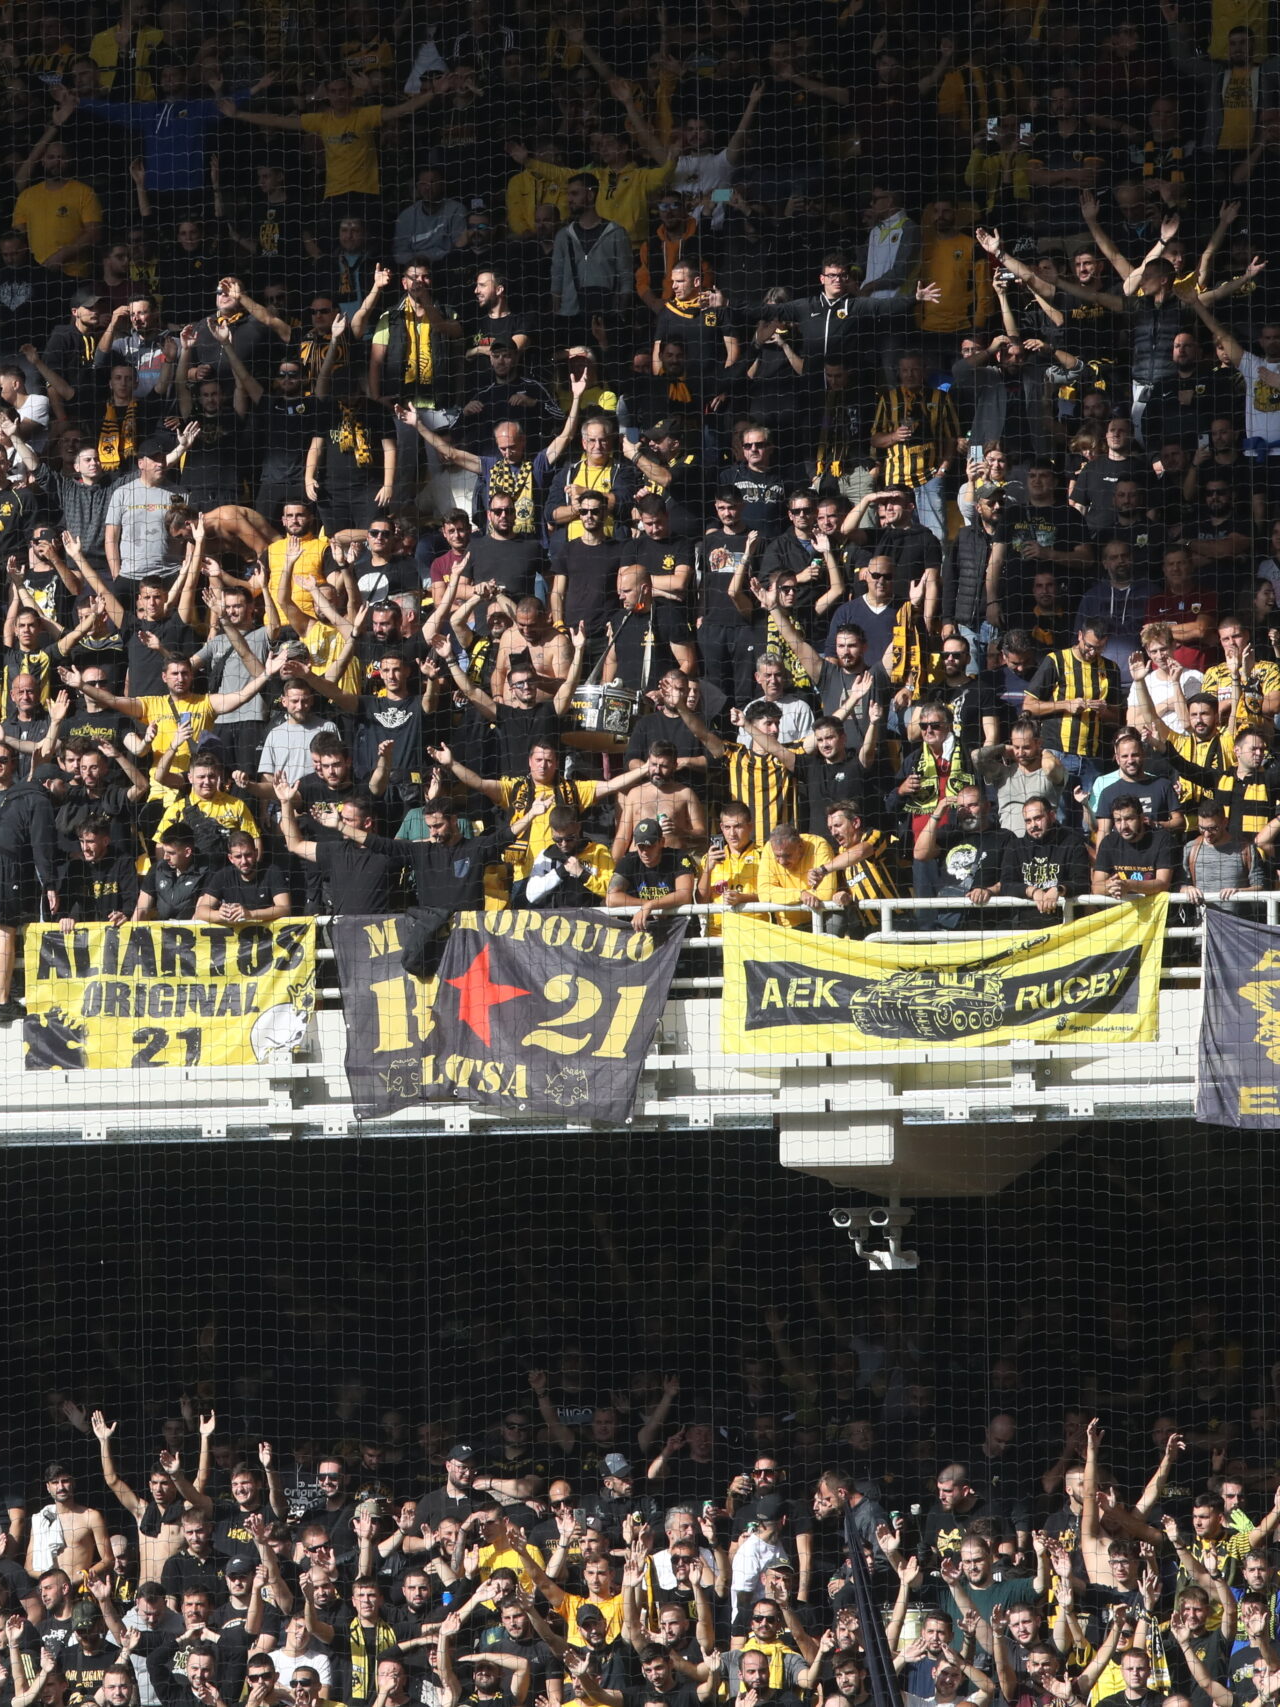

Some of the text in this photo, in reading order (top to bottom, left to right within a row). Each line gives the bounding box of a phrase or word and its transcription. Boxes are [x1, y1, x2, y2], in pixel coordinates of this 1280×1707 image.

[37, 923, 304, 981] ALIARTOS
[80, 980, 261, 1018] ORIGINAL
[760, 967, 1130, 1013] AEK RUGBY
[521, 974, 648, 1058] 21
[131, 1026, 202, 1068] 21
